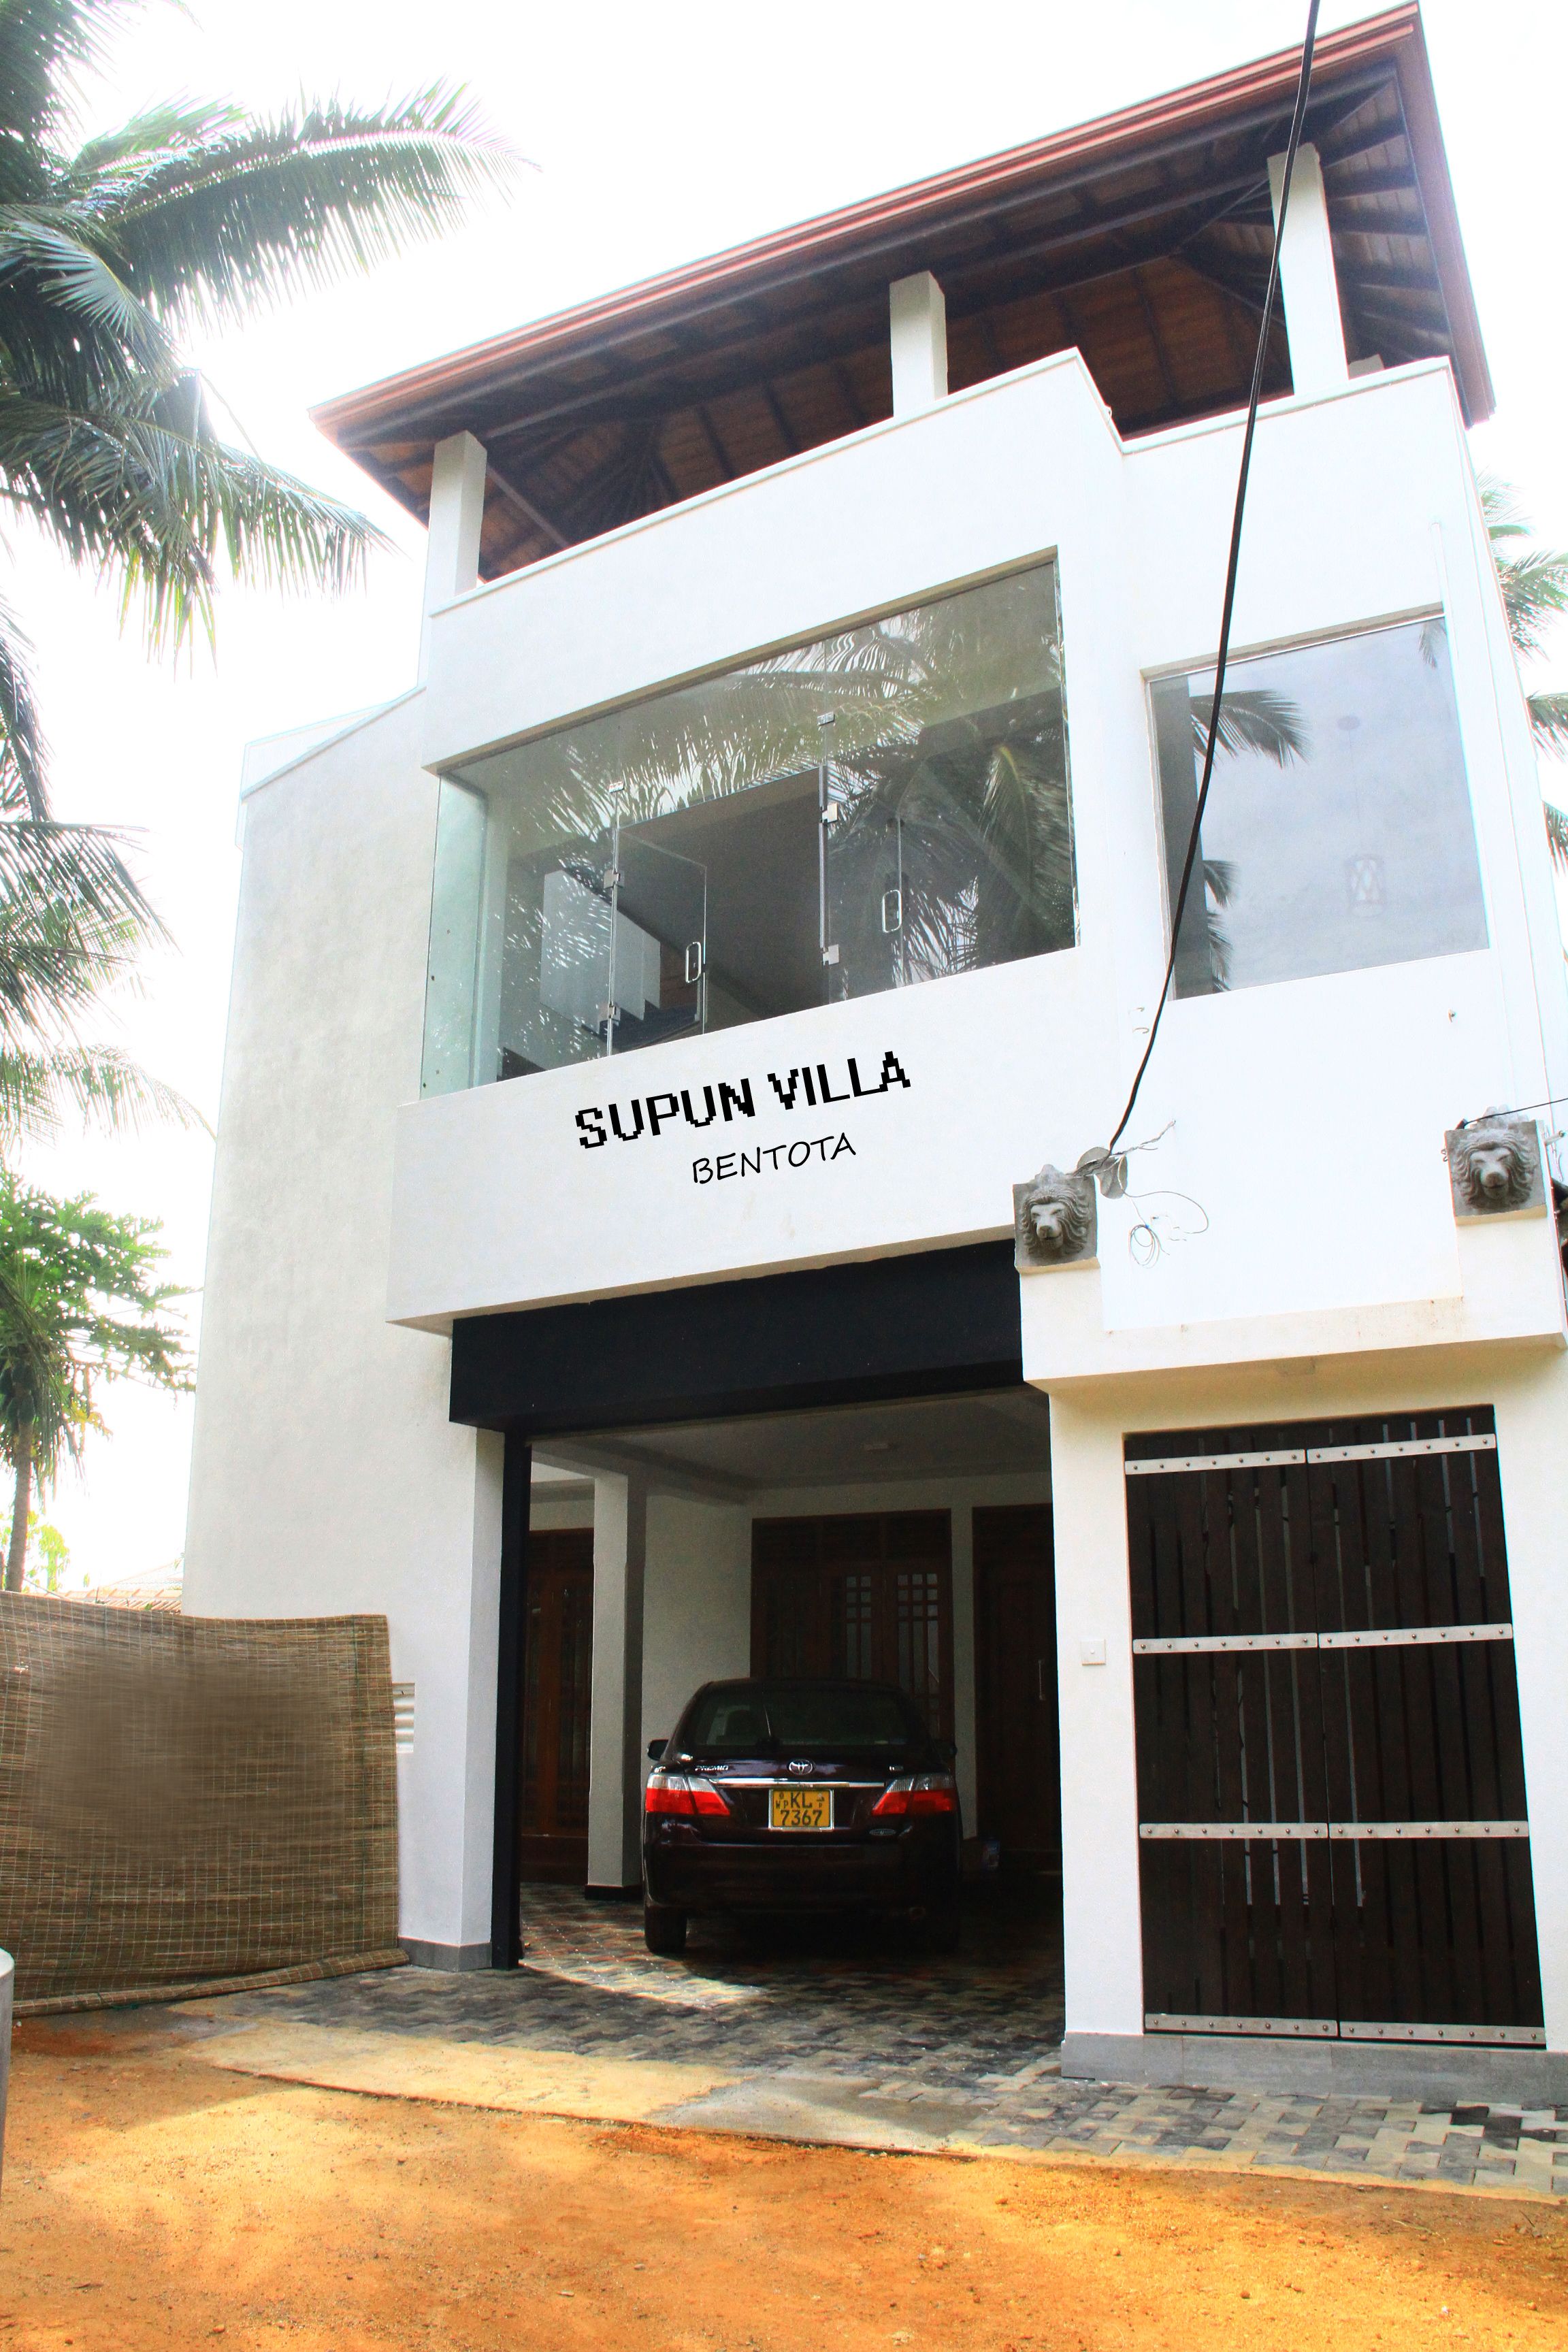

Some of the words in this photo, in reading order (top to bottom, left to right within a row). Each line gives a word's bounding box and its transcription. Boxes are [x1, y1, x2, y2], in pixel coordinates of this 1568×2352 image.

[575, 1077, 755, 1149] SUPUN
[767, 1051, 911, 1110] VILLA
[692, 1132, 856, 1184] BENTOTA
[790, 1792, 813, 1808] KL
[780, 1809, 823, 1826] 7367
